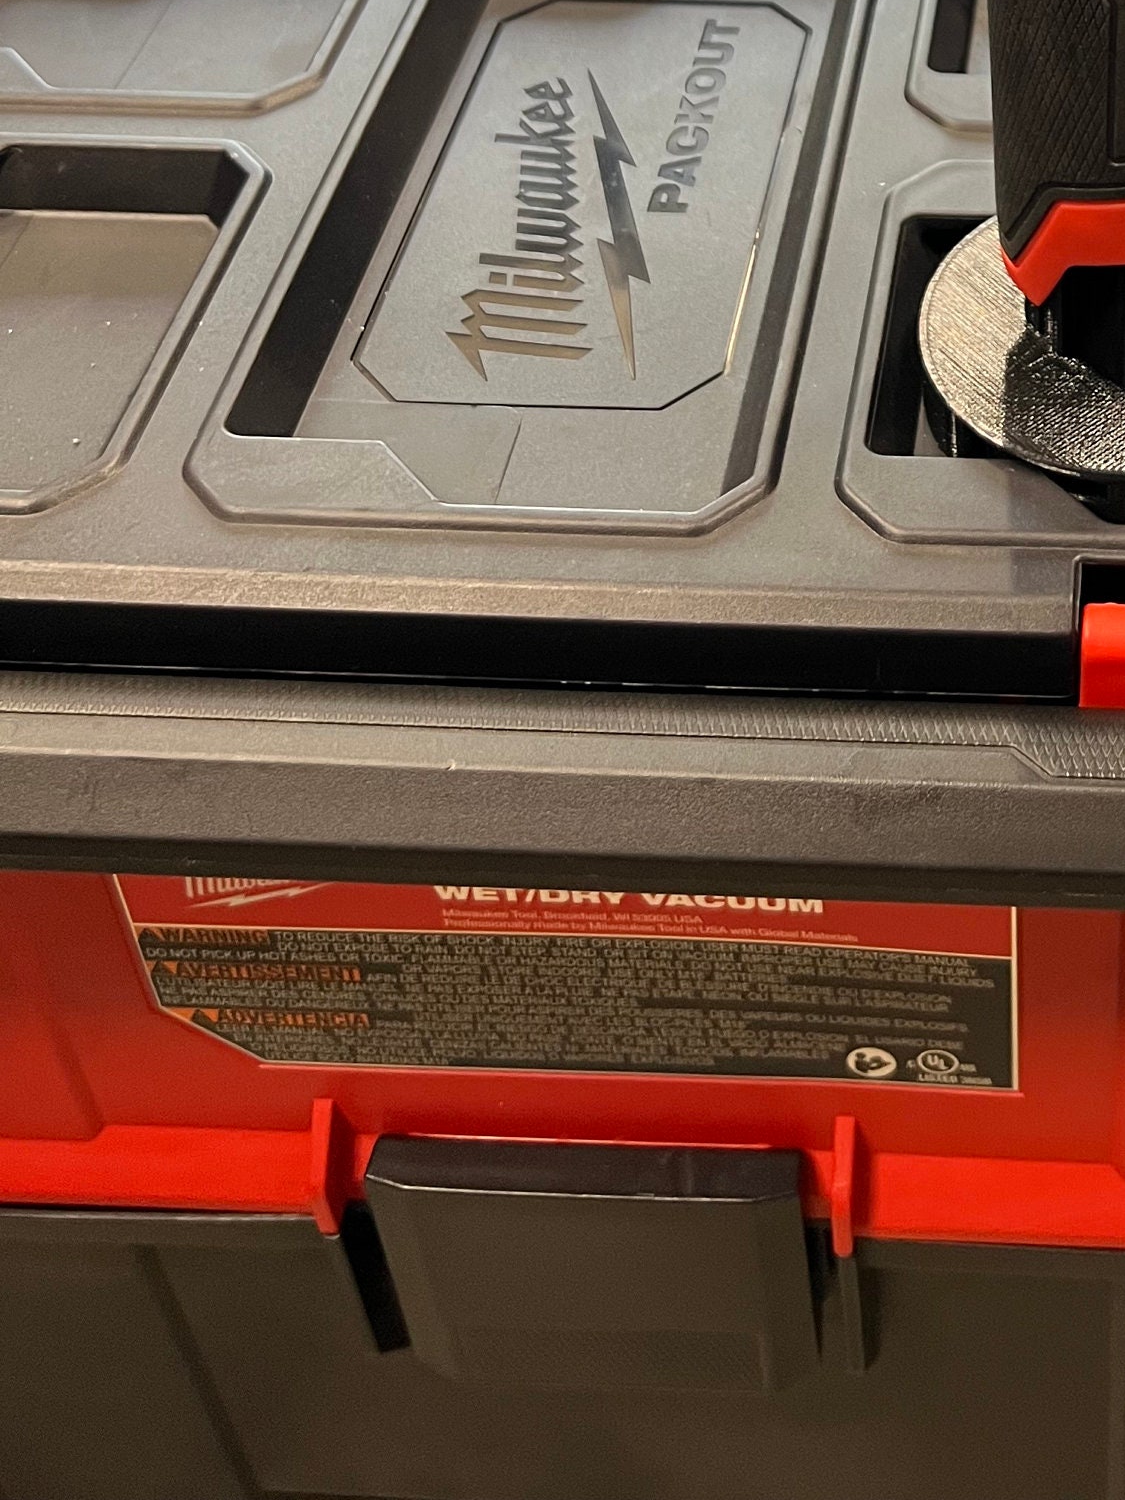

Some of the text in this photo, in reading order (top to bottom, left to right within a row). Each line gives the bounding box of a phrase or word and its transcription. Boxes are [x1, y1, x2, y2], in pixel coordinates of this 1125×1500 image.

[647, 18, 741, 213] PACKOUT
[446, 77, 594, 382] Milwaukee
[433, 885, 823, 913] WET/DRY VACUUM
[160, 928, 269, 944] WARNING
[275, 931, 293, 940] TO
[298, 932, 354, 941] REDUCE
[360, 933, 384, 942] THE
[784, 947, 821, 957] READ
[279, 941, 298, 950] DO
[146, 947, 166, 957] DO
[170, 948, 196, 957] NOT
[202, 949, 232, 958] PICK
[236, 949, 255, 959] UP
[260, 950, 286, 959] HOT
[290, 951, 336, 960] ASHES
[339, 952, 359, 961] OR
